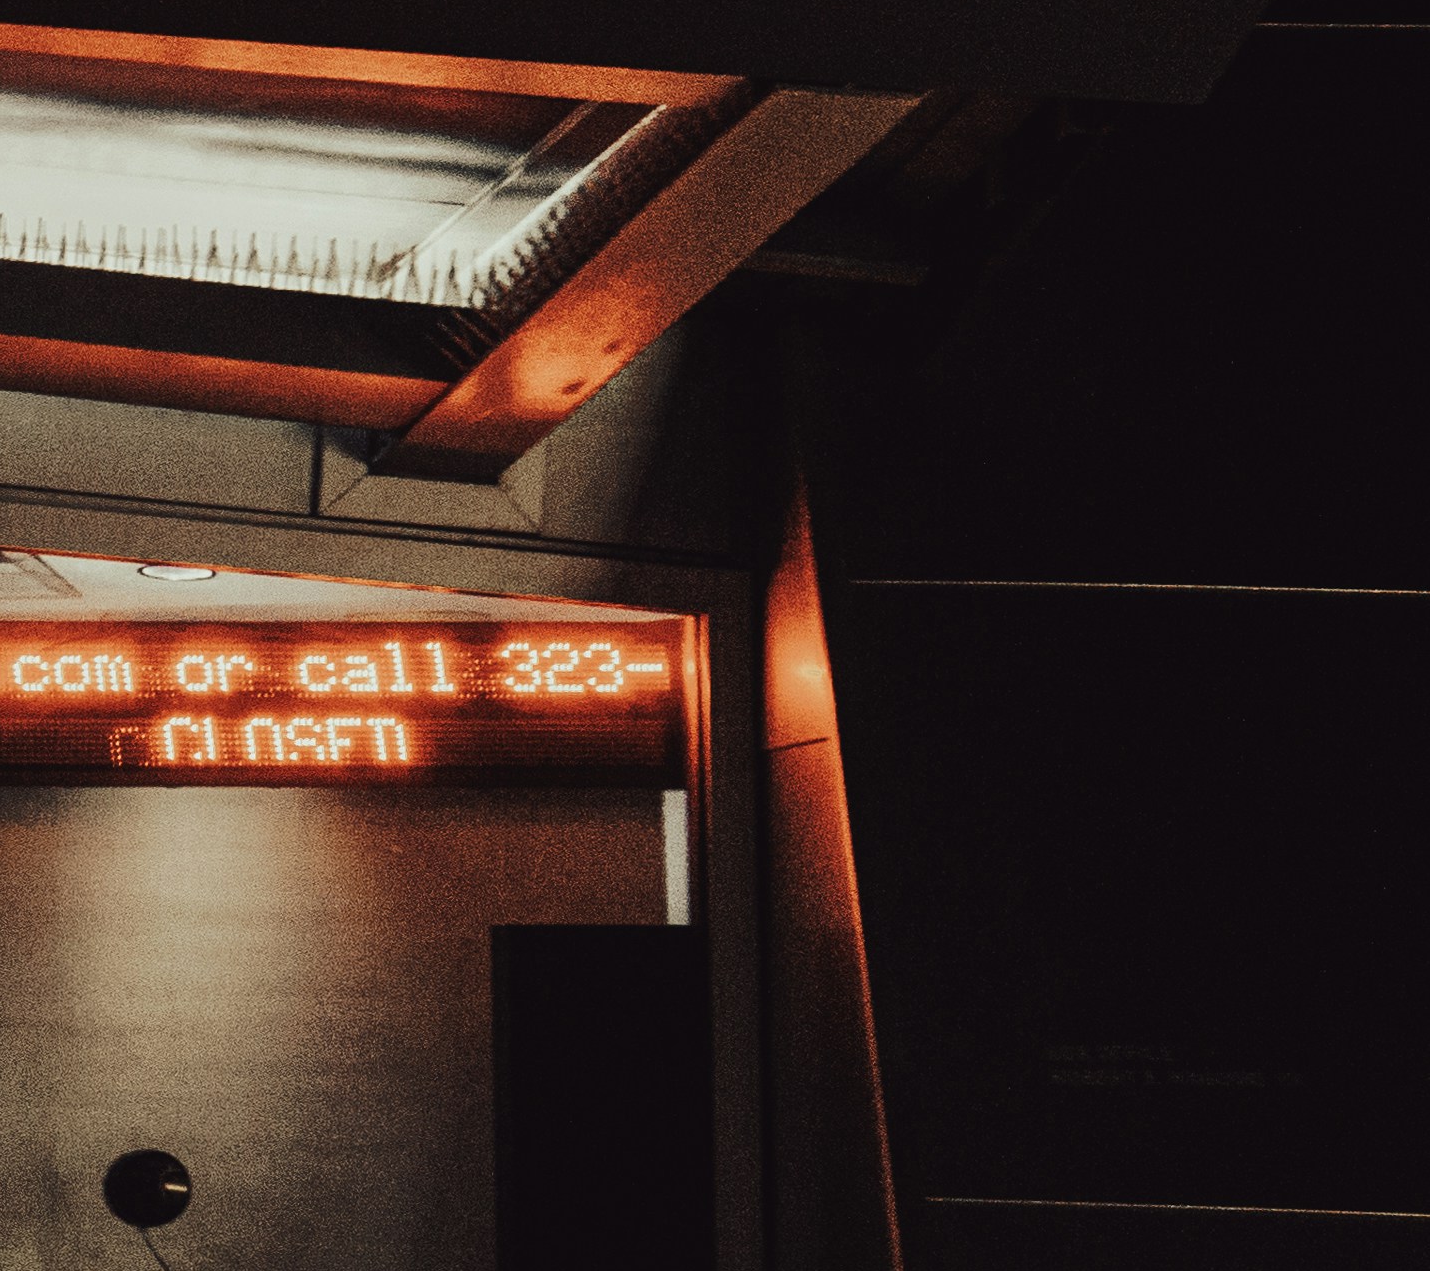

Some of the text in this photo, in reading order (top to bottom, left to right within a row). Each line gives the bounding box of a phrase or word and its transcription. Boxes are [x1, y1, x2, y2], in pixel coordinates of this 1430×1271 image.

[175, 651, 253, 694] or
[298, 640, 456, 695] call
[500, 641, 664, 695] 323-
